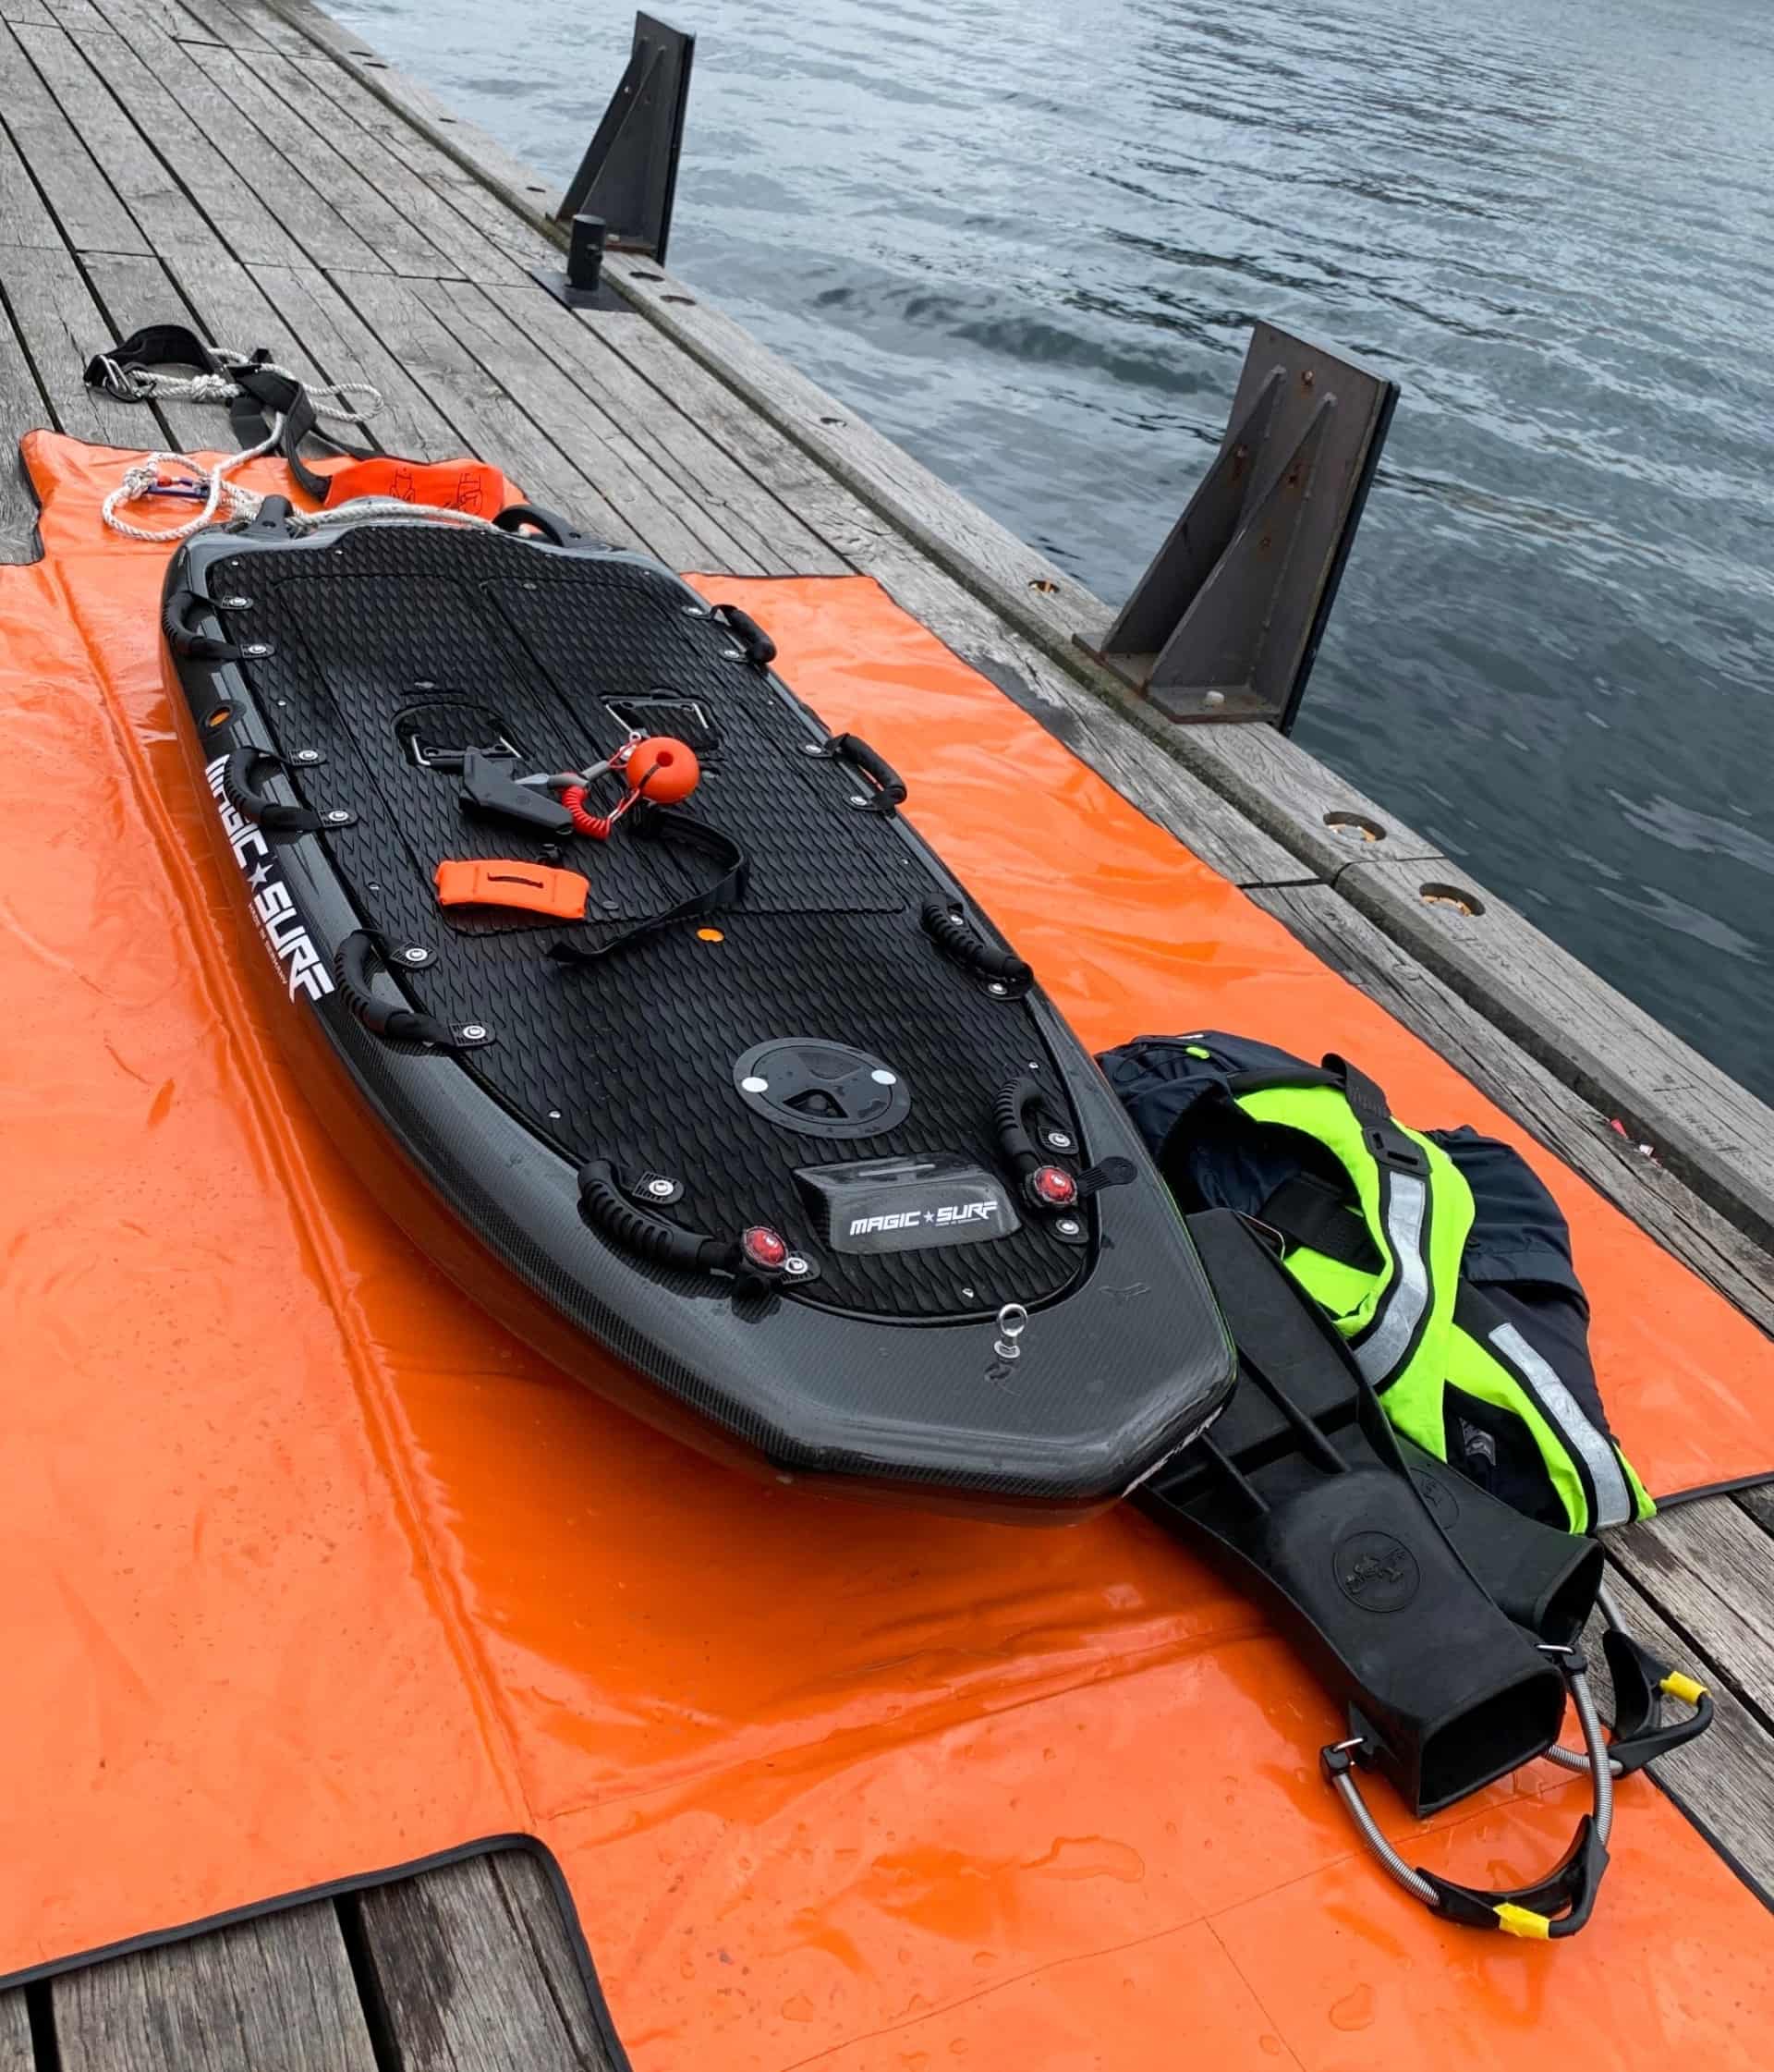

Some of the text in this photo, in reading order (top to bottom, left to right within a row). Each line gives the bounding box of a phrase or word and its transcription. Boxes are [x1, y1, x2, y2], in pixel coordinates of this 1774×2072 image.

[253, 881, 334, 1004] SURF
[849, 1211, 921, 1236] MAGIC
[936, 1201, 998, 1221] SURF
